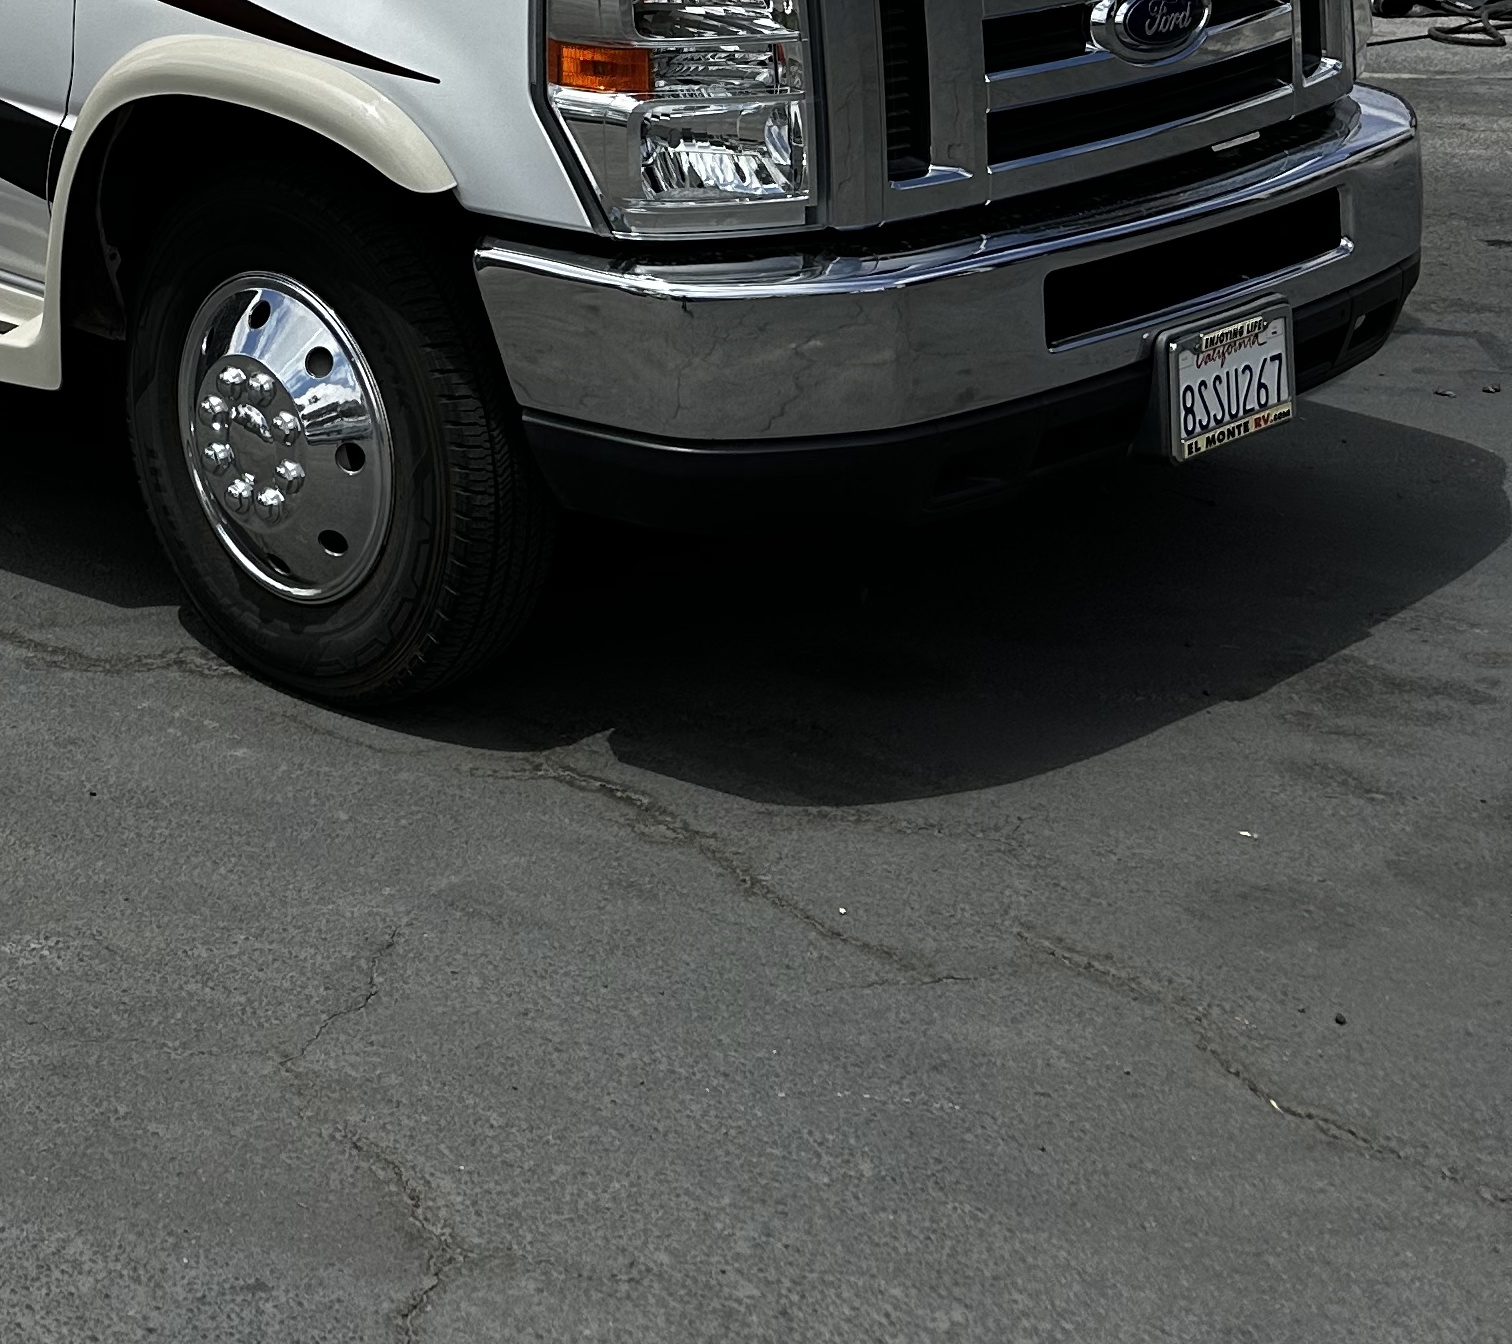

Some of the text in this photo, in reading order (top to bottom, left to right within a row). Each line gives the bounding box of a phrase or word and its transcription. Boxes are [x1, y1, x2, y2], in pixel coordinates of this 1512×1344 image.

[1246, 319, 1263, 335] LIFE
[1182, 353, 1283, 437] 8SSU267
[1187, 441, 1201, 456] EL
[1205, 421, 1250, 448] MONTE
